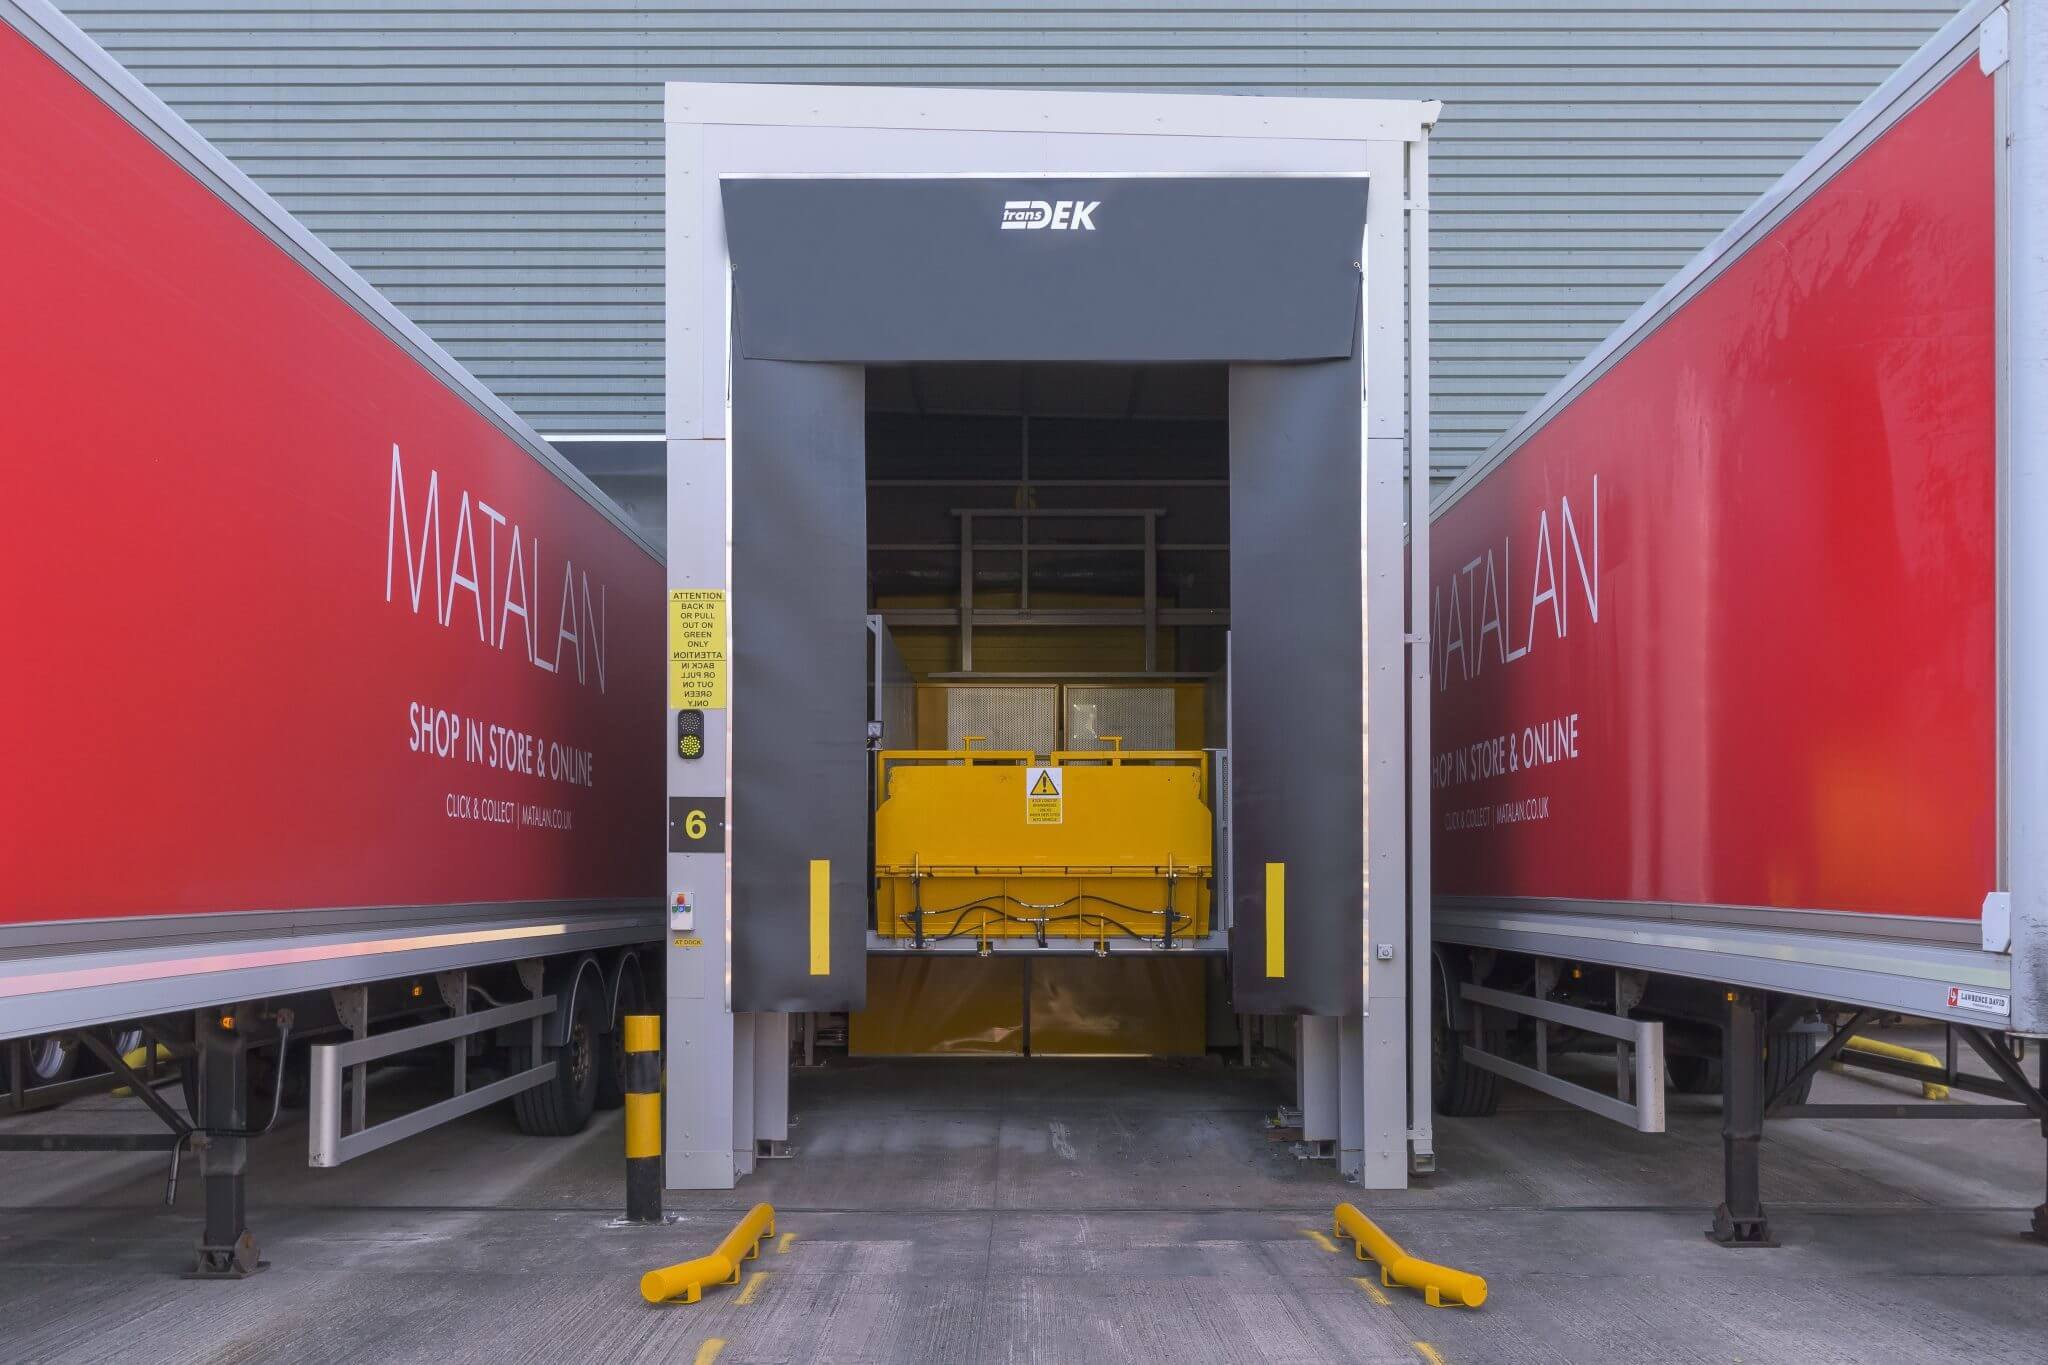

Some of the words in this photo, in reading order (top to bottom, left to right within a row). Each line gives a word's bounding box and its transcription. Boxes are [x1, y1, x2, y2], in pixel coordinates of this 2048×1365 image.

[386, 442, 606, 694] MATALAN
[409, 701, 460, 759] SHOP
[466, 717, 483, 764] IN
[489, 724, 533, 775] STORE
[537, 738, 546, 778] &
[550, 742, 593, 787] ONLINE
[1432, 752, 1453, 789] HOP
[1456, 746, 1467, 784] IN
[1471, 735, 1505, 781] STORE
[1509, 733, 1518, 772] &
[1522, 713, 1578, 769] ONLINE
[446, 793, 472, 819] CLICK
[473, 797, 479, 819] &
[481, 799, 515, 824] COLLECT
[521, 805, 572, 829] MATALAN.CO.UK
[685, 809, 707, 840] 6
[1466, 806, 1491, 828] COLLECT
[1496, 796, 1549, 824] MATALAN.CO.UK
